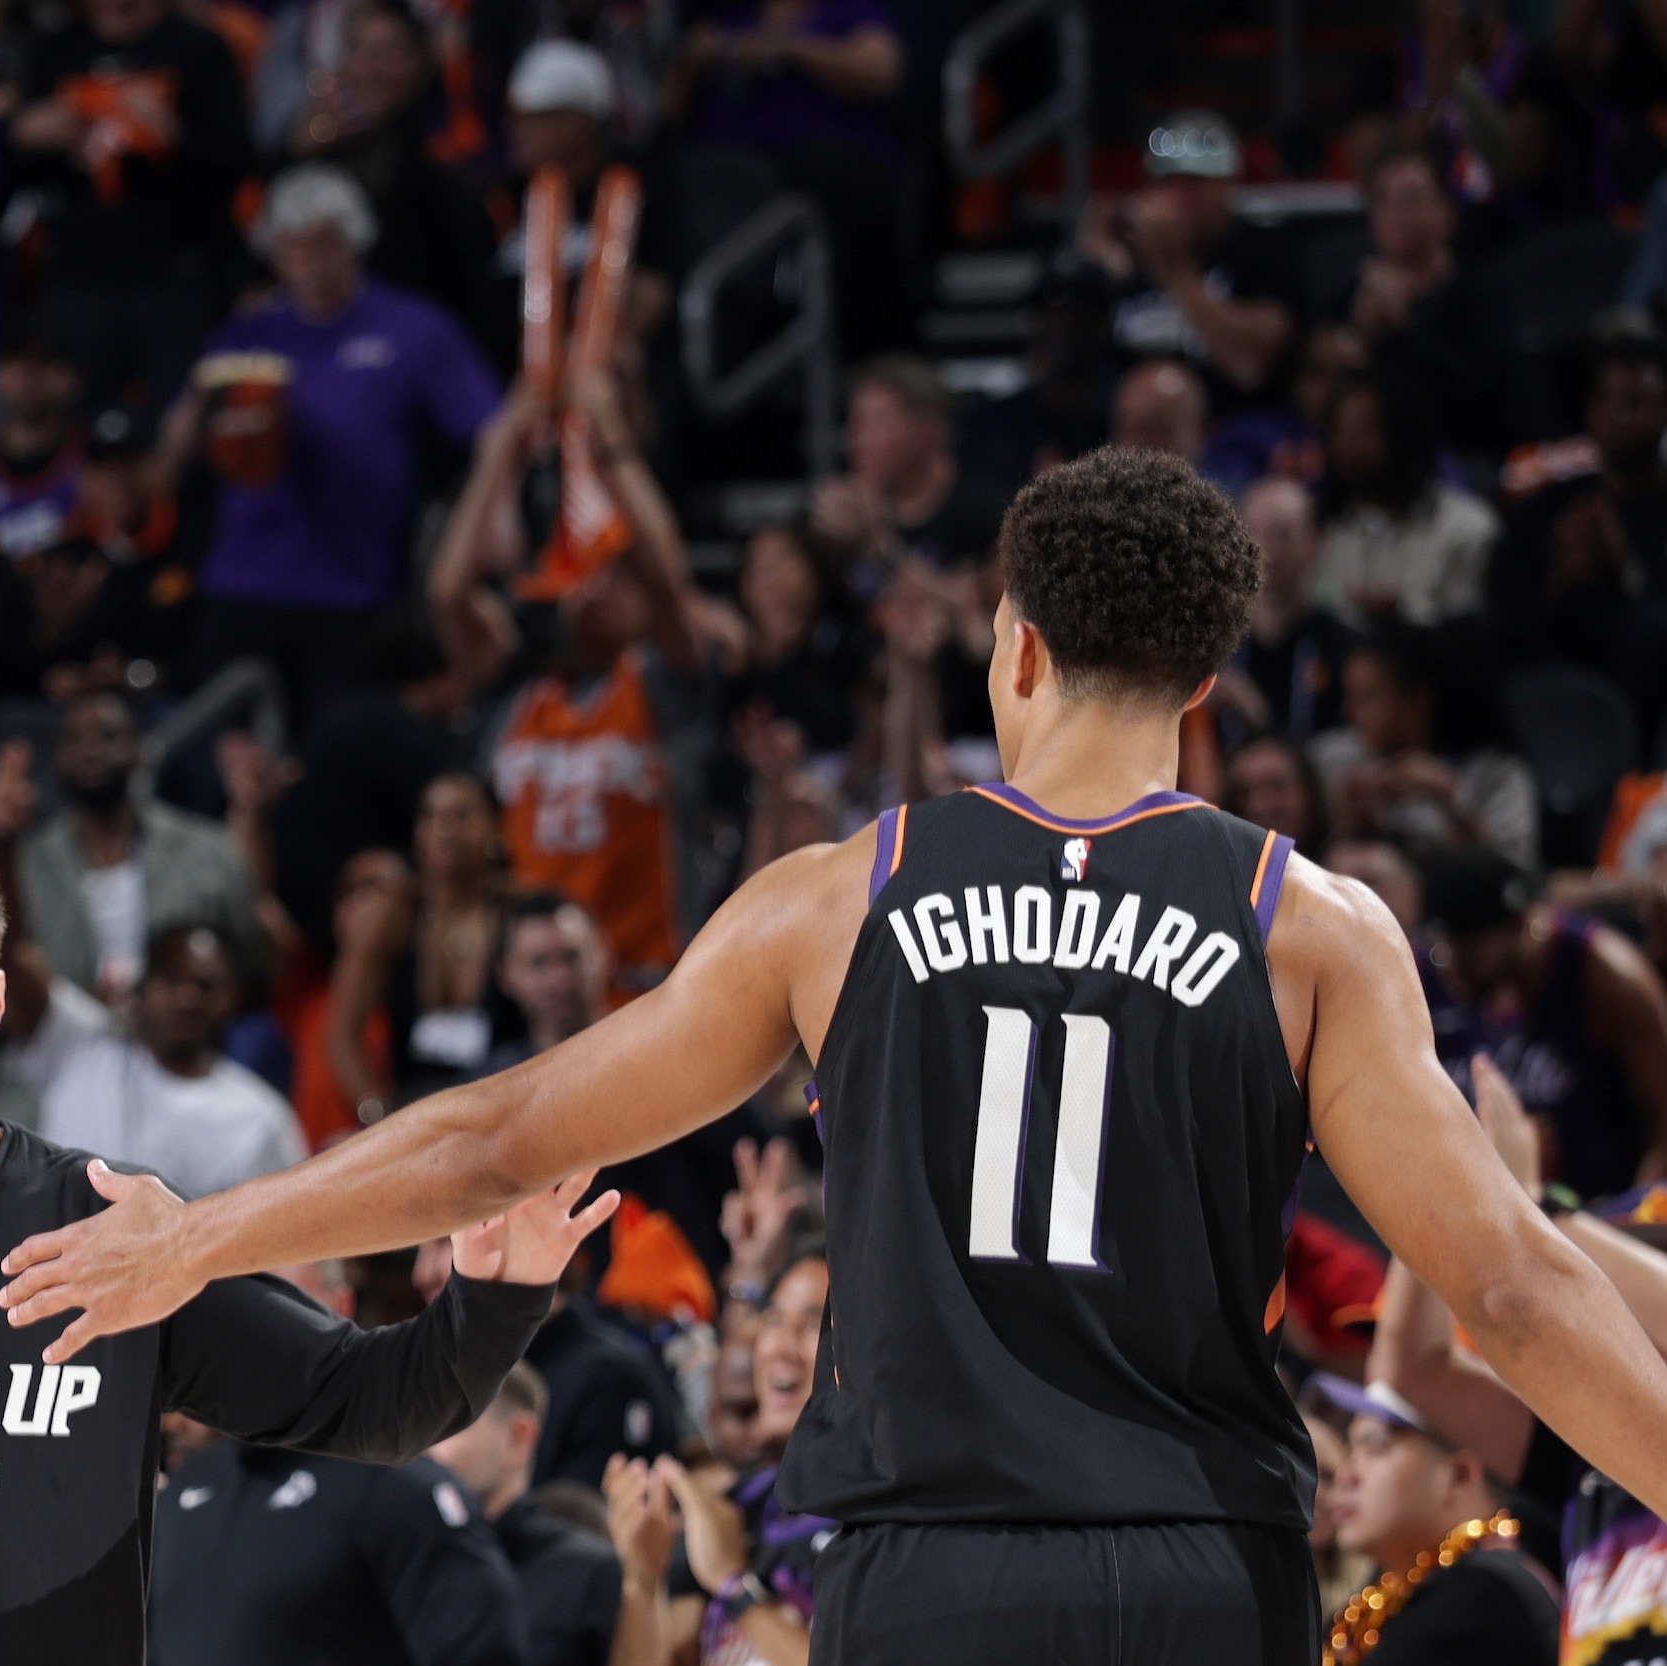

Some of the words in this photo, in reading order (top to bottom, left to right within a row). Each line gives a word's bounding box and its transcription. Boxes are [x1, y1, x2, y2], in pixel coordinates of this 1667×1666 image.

[888, 884, 1241, 1007] IGHODARO
[967, 1004, 1115, 1274] 11
[1, 1364, 102, 1437] UP
